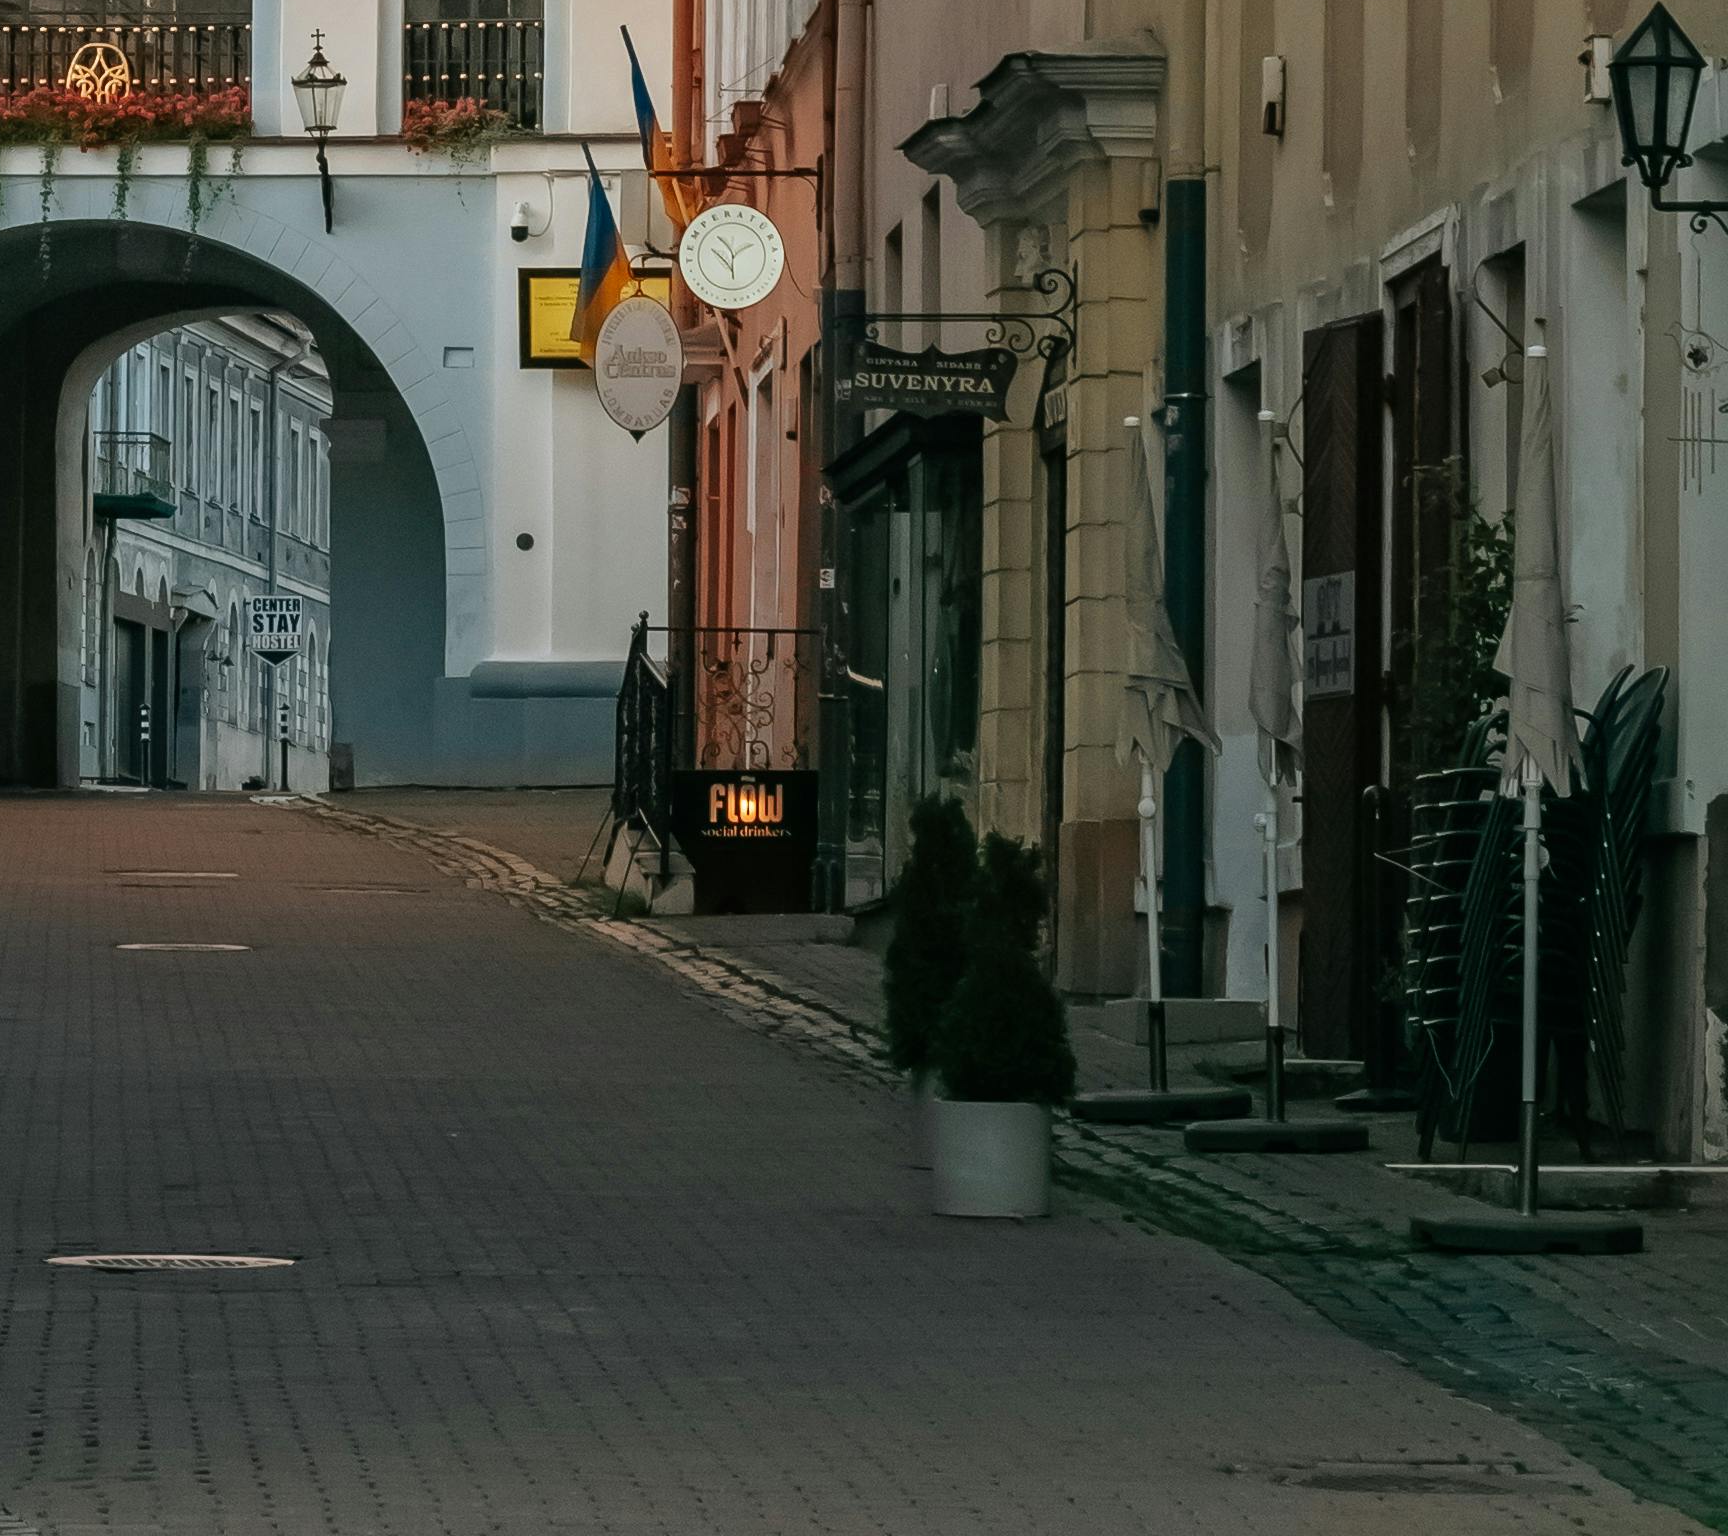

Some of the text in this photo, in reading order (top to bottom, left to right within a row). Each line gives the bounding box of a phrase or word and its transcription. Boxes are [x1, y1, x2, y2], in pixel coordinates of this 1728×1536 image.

[855, 372, 996, 394] SUVENYRA
[253, 598, 301, 612] CENTER
[253, 613, 300, 633] STAY
[252, 635, 301, 649] HOSTEL
[701, 826, 792, 838] social drinkers
